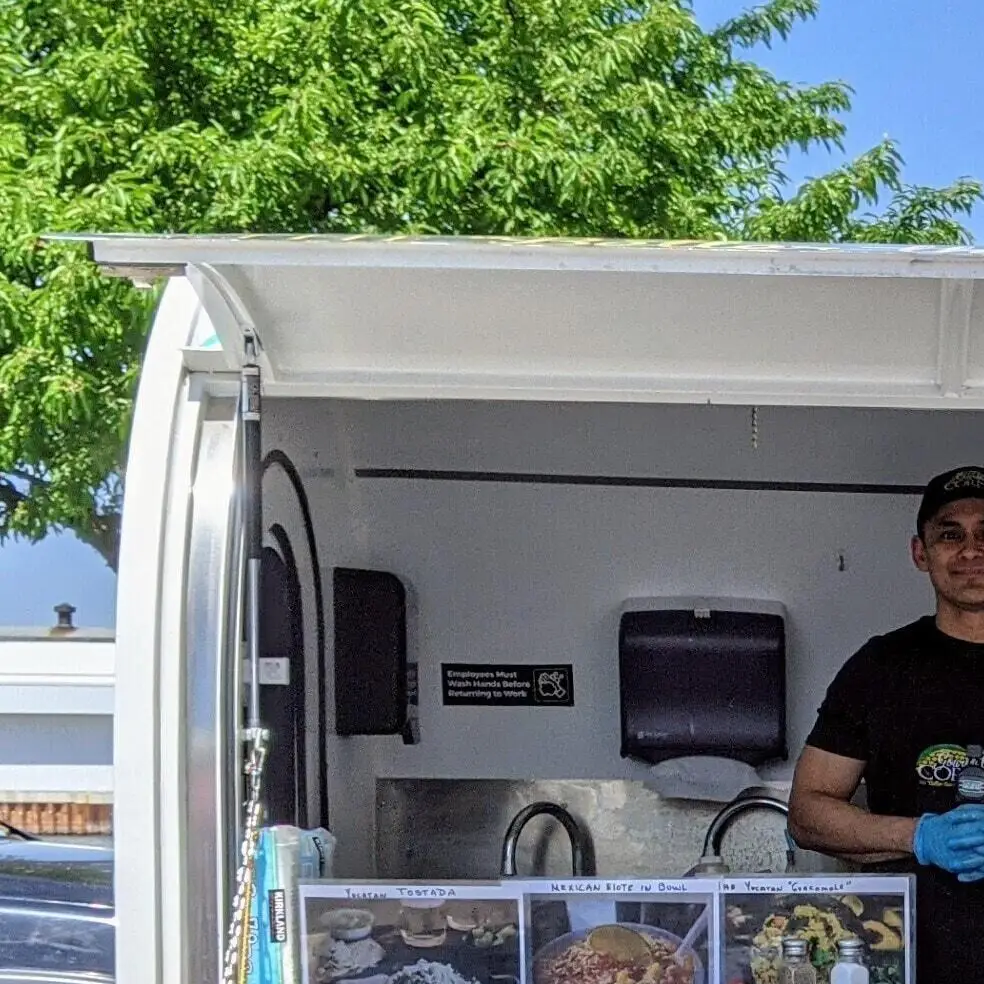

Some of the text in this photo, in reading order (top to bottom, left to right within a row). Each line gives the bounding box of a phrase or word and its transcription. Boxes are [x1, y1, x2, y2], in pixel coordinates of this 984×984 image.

[447, 670, 495, 680] Employees
[447, 680, 472, 688] Wash
[473, 680, 500, 688] Hands
[448, 690, 527, 699] Returning to Work
[396, 887, 457, 897] TOSTADA
[551, 882, 600, 892] MEXICAN
[274, 891, 286, 941] KIRKLAND
